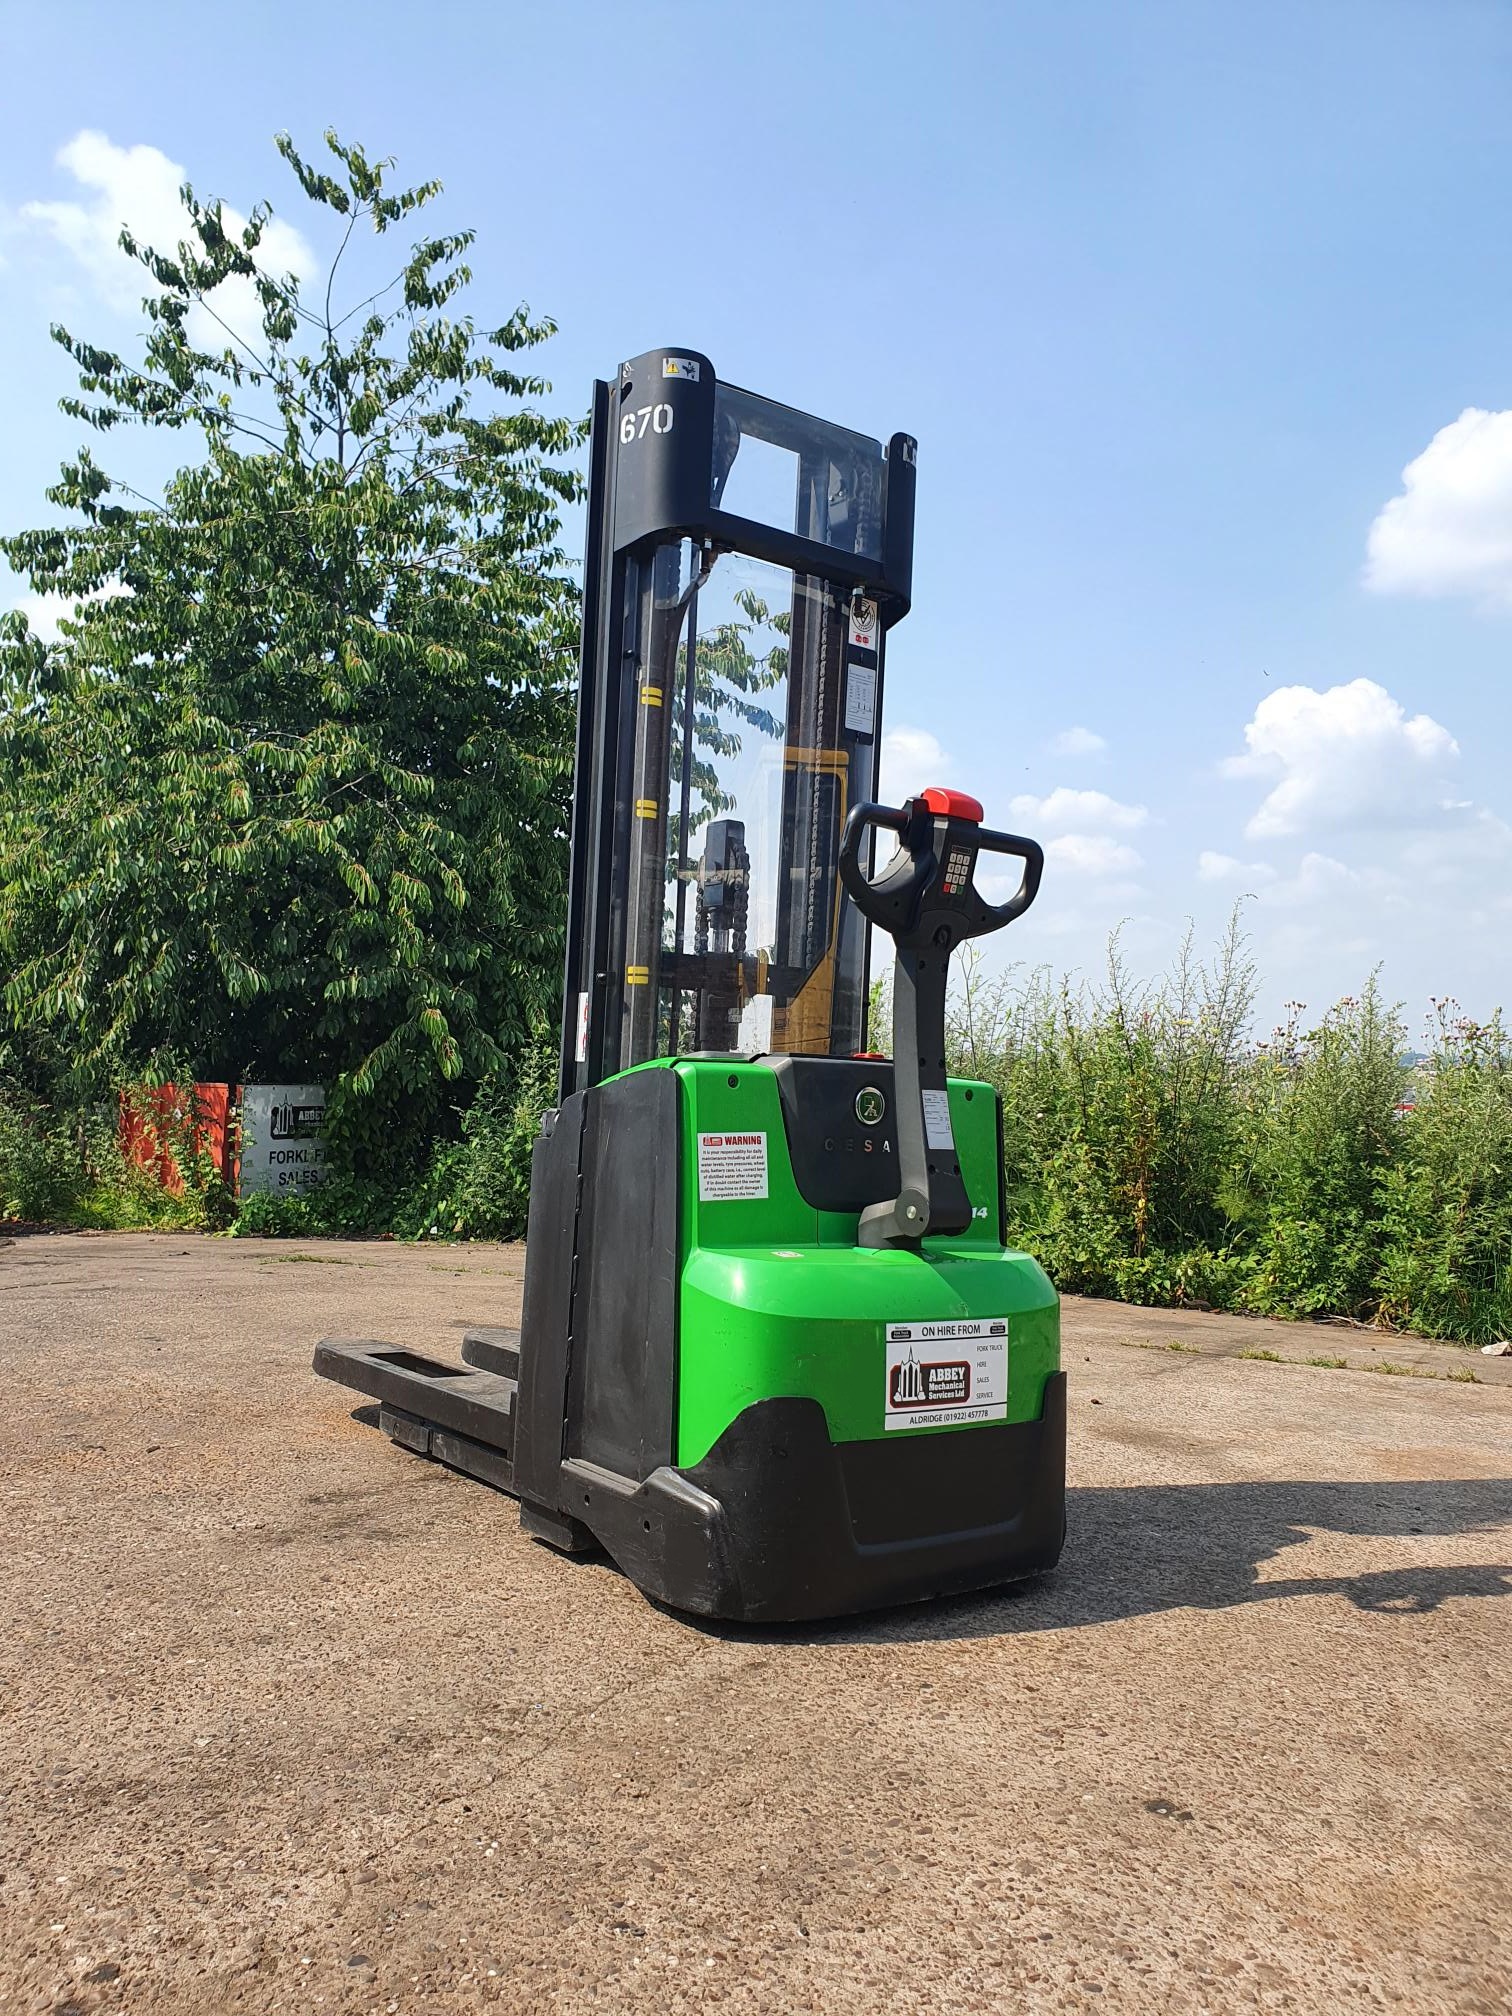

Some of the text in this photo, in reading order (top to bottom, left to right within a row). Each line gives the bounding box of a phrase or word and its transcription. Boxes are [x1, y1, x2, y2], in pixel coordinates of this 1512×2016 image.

[620, 404, 673, 444] 670
[298, 1110, 325, 1120] ABBEY
[725, 1136, 762, 1145] WARNING
[269, 1148, 327, 1165] FORKLF
[278, 1170, 318, 1186] SALES
[921, 1326, 935, 1336] ON
[937, 1325, 956, 1336] HIRE
[958, 1324, 980, 1335] FROM
[929, 1367, 965, 1382] ABBEY
[928, 1381, 965, 1391] Mechanical
[928, 1390, 965, 1400] Services Ltd
[976, 1391, 993, 1399] SERVICE
[909, 1410, 989, 1425] ALDRIDGE (01922) 457778
